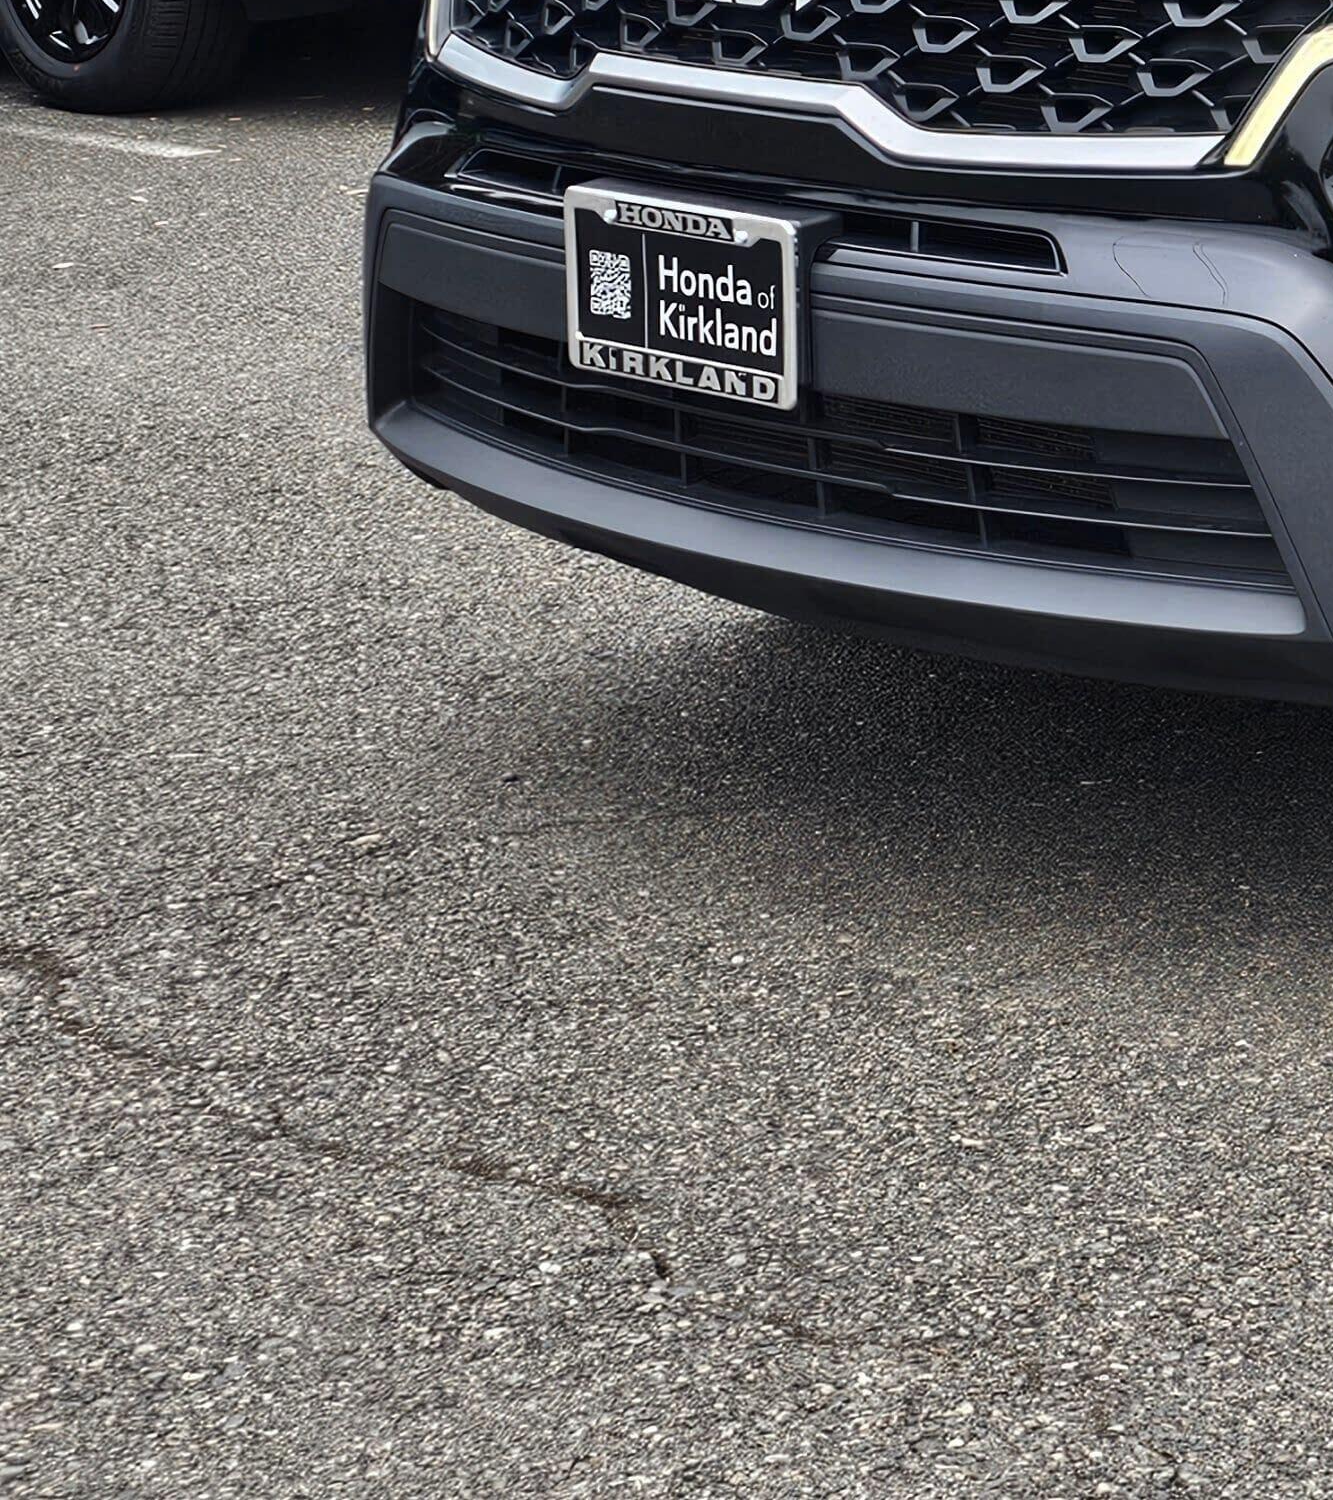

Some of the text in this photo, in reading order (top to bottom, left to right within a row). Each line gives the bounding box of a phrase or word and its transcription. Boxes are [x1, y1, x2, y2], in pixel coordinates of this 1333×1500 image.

[614, 202, 733, 240] HONDA
[657, 254, 776, 310] Honda of
[658, 299, 778, 357] Kirkland
[581, 341, 777, 401] KIRKLAND
